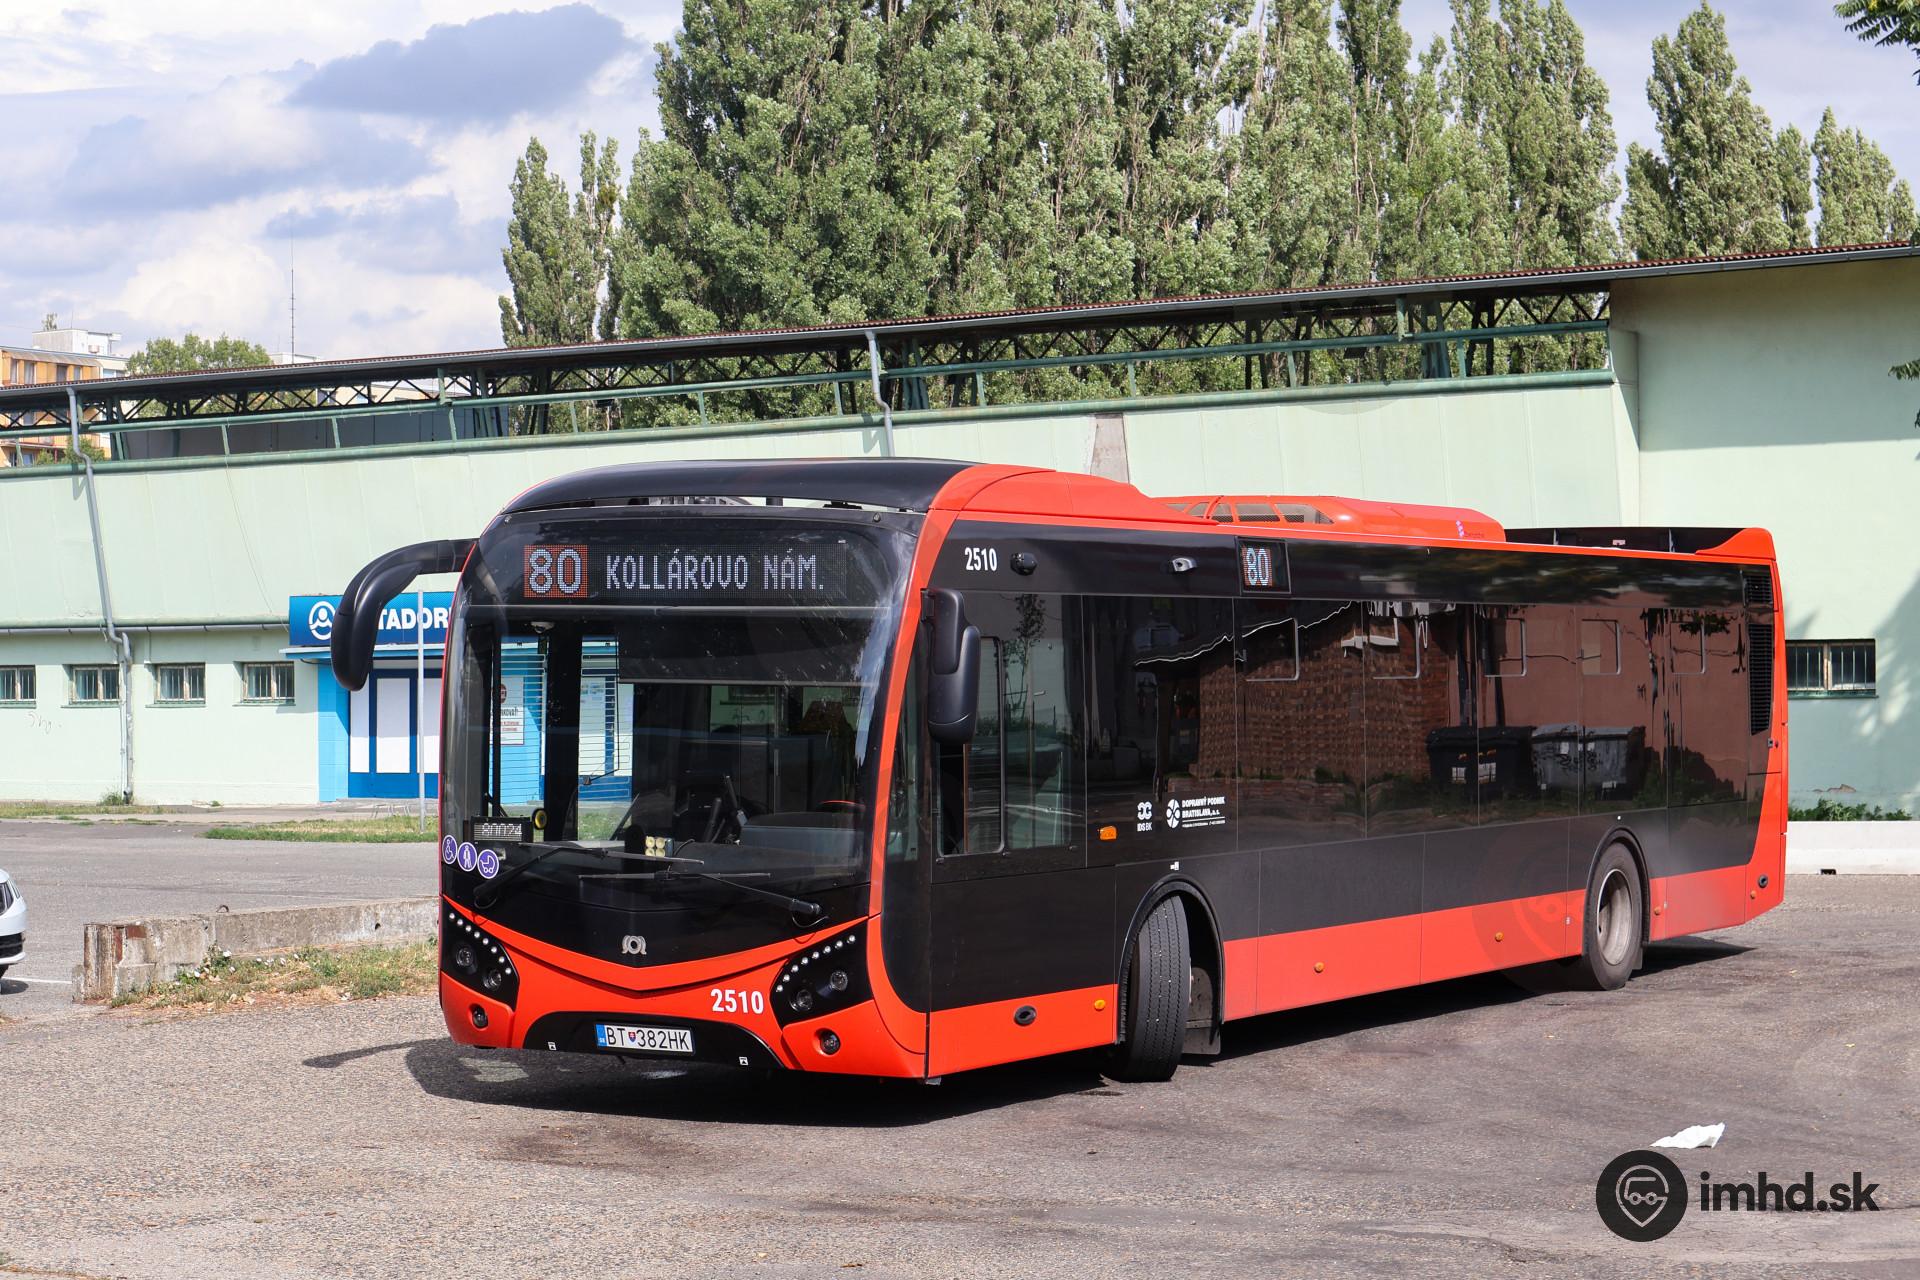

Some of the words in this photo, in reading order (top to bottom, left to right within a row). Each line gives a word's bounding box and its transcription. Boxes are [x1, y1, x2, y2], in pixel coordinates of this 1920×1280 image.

[529, 549, 581, 594] 80
[606, 548, 748, 590] KOLLÁROVO
[763, 548, 824, 590] NÁM.
[964, 547, 998, 572] 2510
[1244, 547, 1270, 585] 80
[378, 607, 451, 630] TADOR
[710, 988, 764, 1015] 2510
[606, 1027, 625, 1046] BT
[636, 1029, 690, 1050] 382HK
